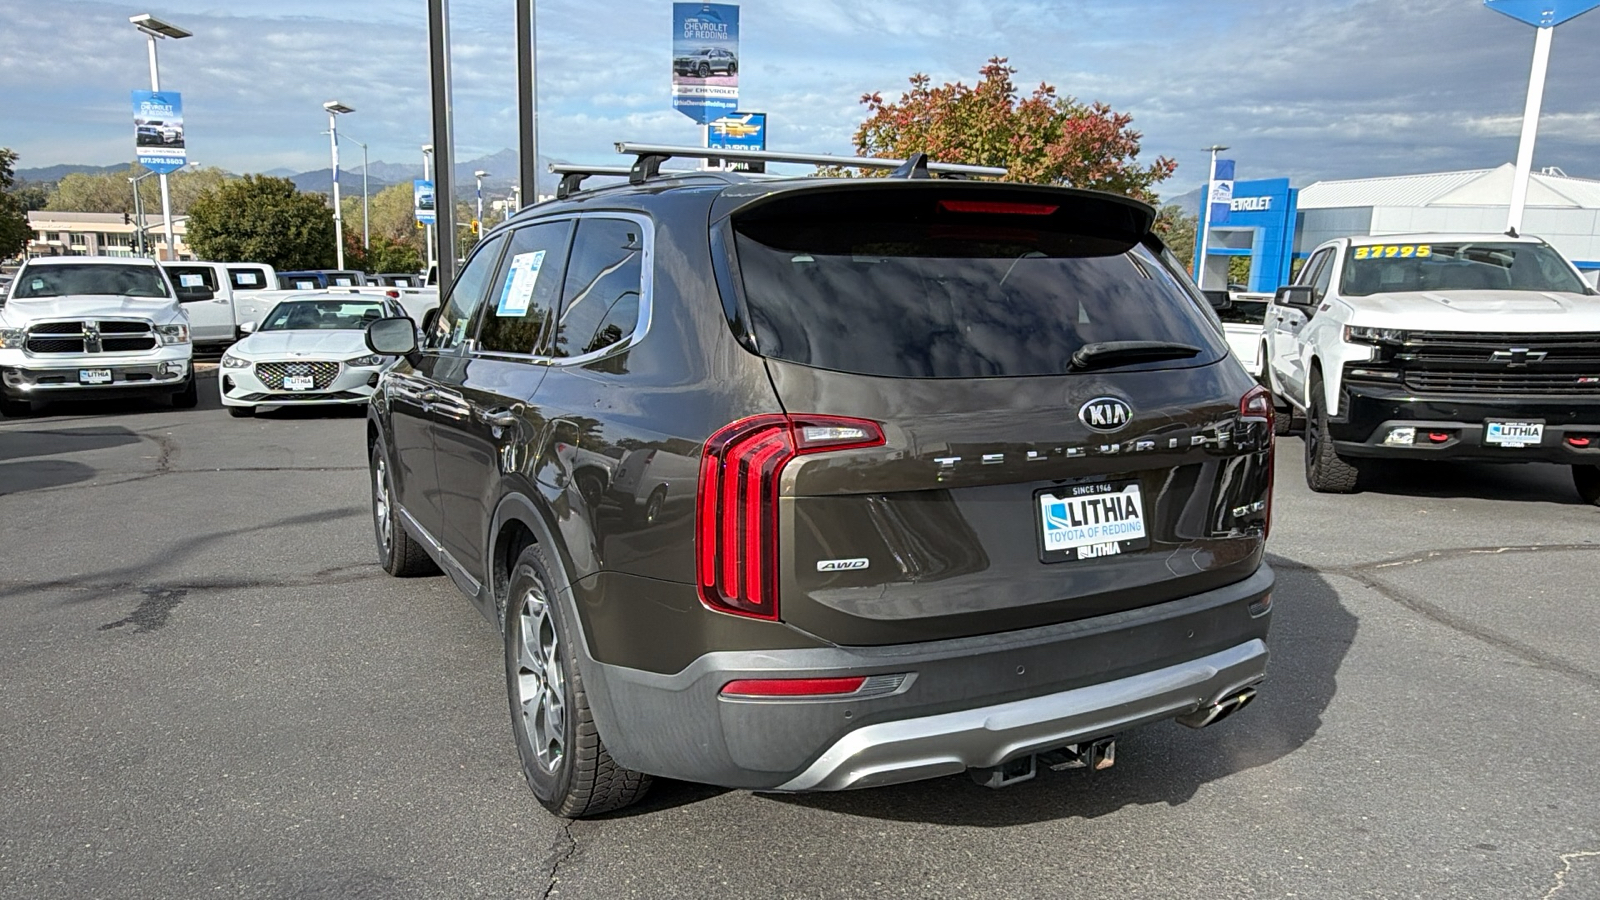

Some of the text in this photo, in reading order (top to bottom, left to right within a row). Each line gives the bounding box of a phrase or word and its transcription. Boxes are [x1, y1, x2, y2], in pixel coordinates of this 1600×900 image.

[684, 22, 728, 32] CHEVROLET
[695, 30, 728, 40] REDDING
[1354, 245, 1430, 259] 37995
[1088, 403, 1127, 425] KIA
[1501, 426, 1540, 436] LITHIA
[1072, 483, 1112, 495] SINCE 1946
[1067, 494, 1140, 528] LITHIA
[1048, 520, 1142, 543] TOYOTA OF REDDING
[1088, 541, 1121, 558] LITHIA
[820, 560, 867, 570] AWD
